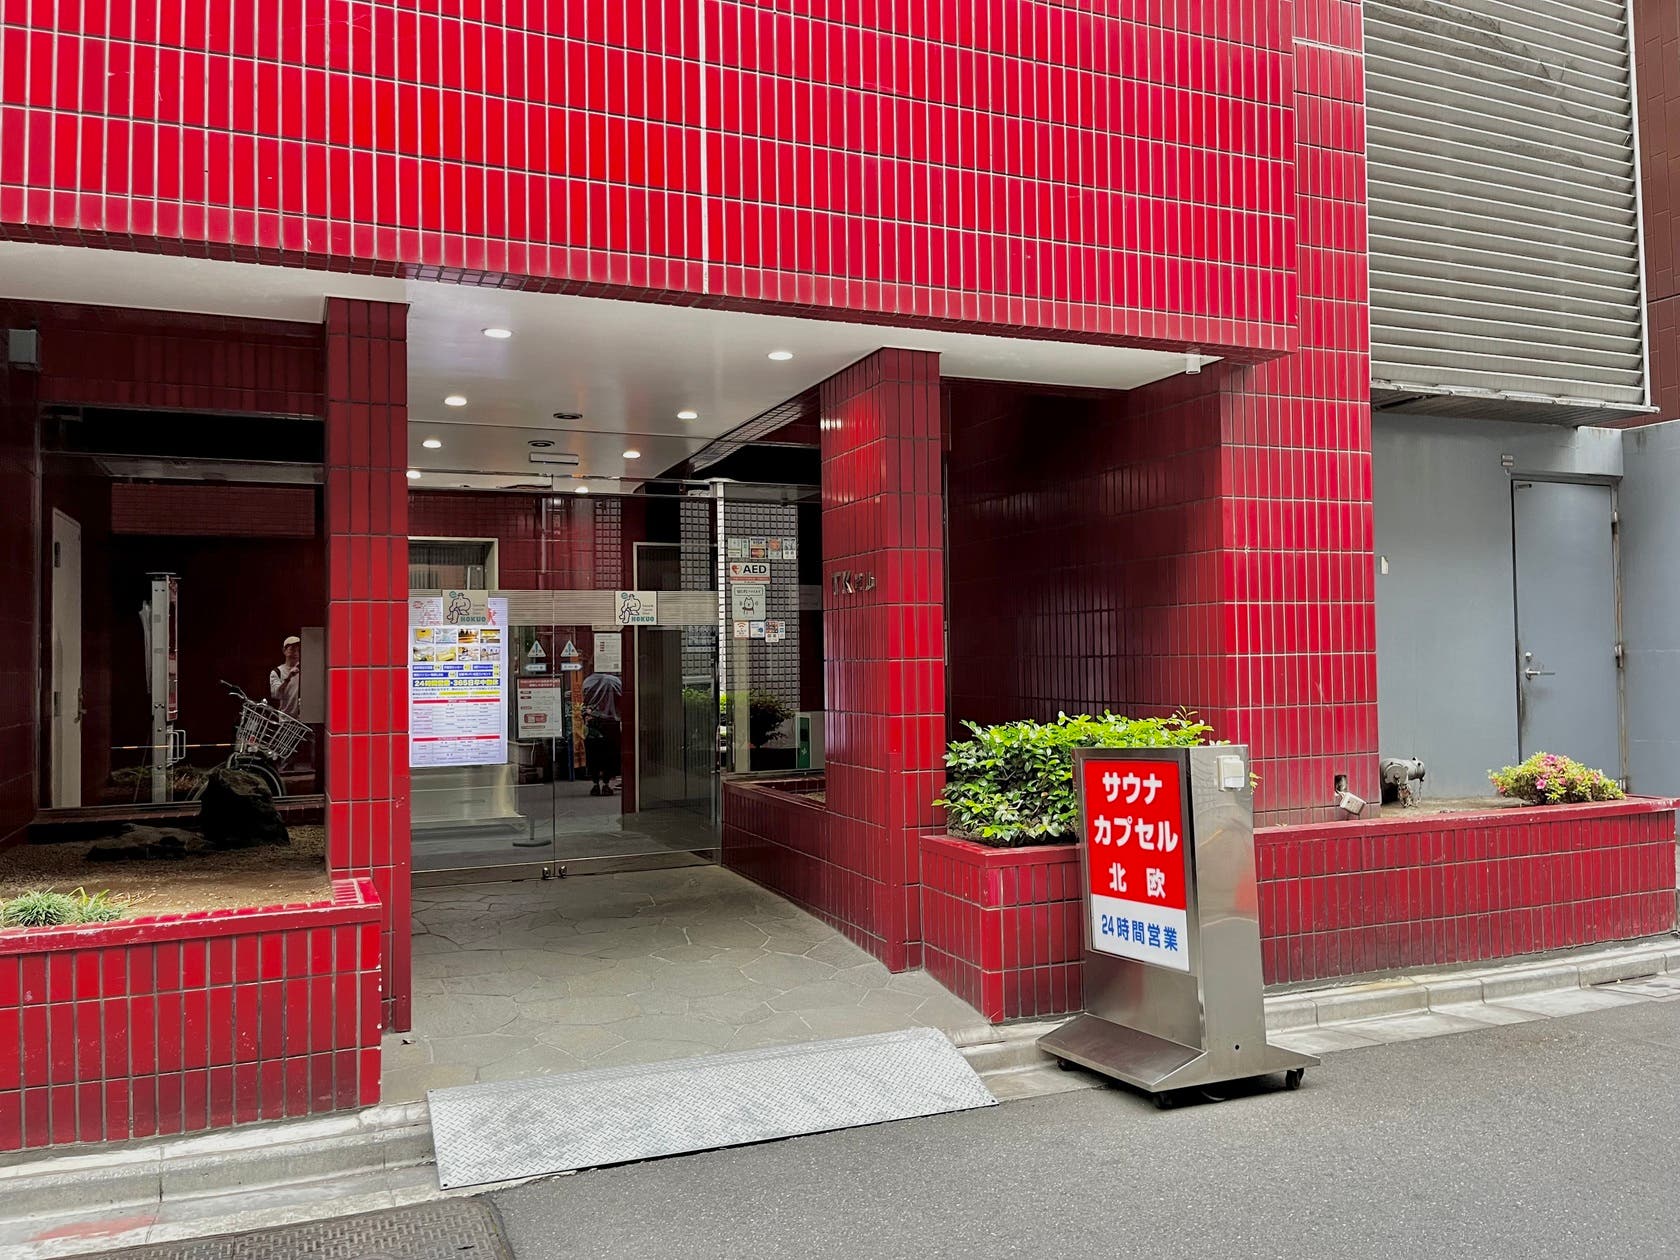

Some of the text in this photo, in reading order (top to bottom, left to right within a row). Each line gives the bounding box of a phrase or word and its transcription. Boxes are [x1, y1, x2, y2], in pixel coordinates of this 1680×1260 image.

[743, 565, 767, 574] AED
[1102, 771, 1163, 805] サウナ
[1093, 814, 1179, 853] カプセル
[1101, 914, 1179, 952] 24時間営業
